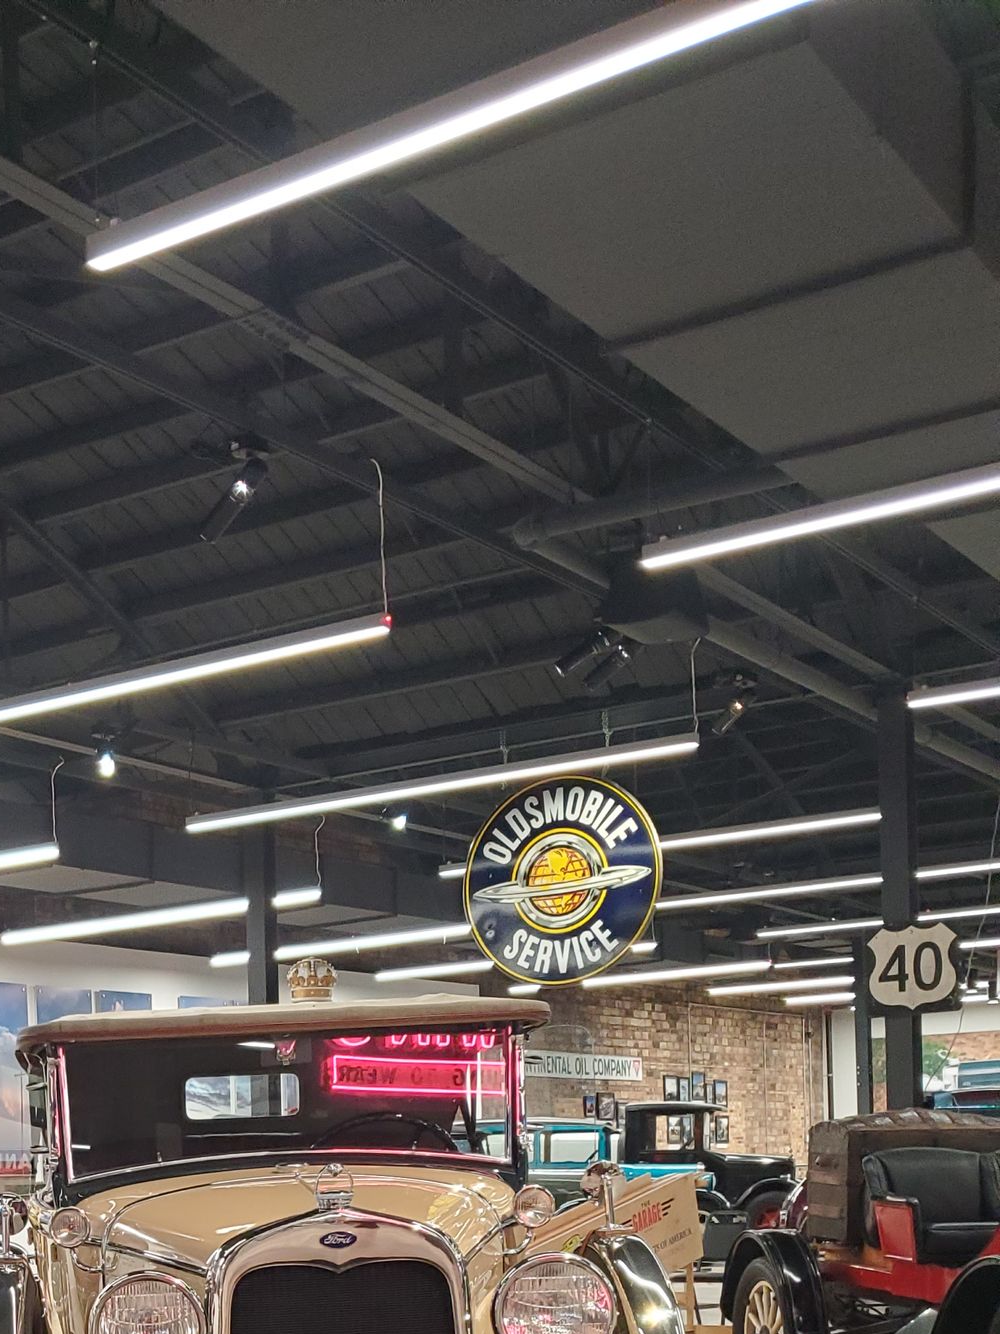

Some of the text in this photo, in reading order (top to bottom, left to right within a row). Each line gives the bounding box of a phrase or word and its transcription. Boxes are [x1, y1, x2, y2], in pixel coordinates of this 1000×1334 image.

[483, 787, 638, 865] OLDSMOBILE
[504, 919, 619, 974] SERVICE
[879, 942, 942, 992] 40
[575, 1058, 589, 1075] OIL
[594, 1058, 631, 1076] COMPANY
[632, 1202, 662, 1232] GARAGE
[323, 1233, 354, 1245] Ford
